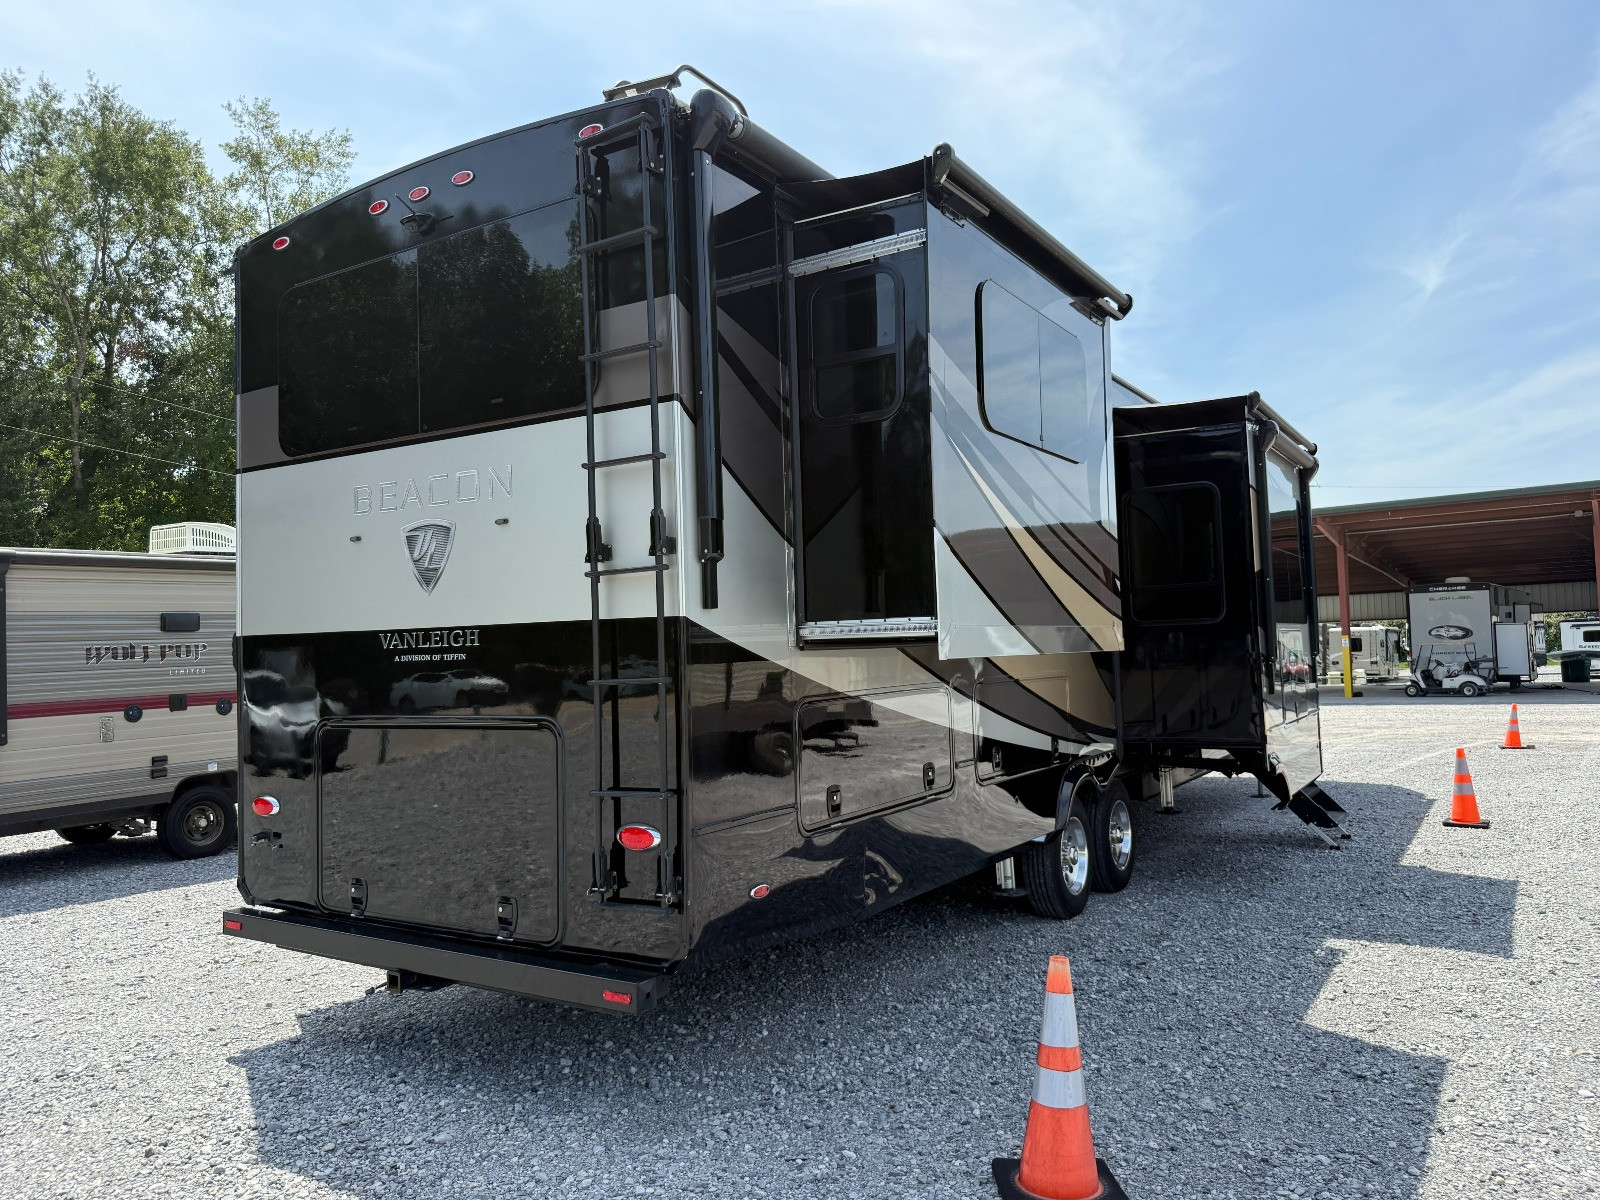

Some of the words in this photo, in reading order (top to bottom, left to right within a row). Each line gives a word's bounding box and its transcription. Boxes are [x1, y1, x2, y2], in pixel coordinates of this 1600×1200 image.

[354, 464, 513, 516] BEACON
[378, 629, 480, 650] VANLEIGH
[84, 641, 155, 666] WOLF
[158, 642, 208, 664] PUP
[401, 654, 431, 662] DIVISION
[443, 653, 467, 661] TIFFIN
[169, 668, 207, 676] LIMITED
